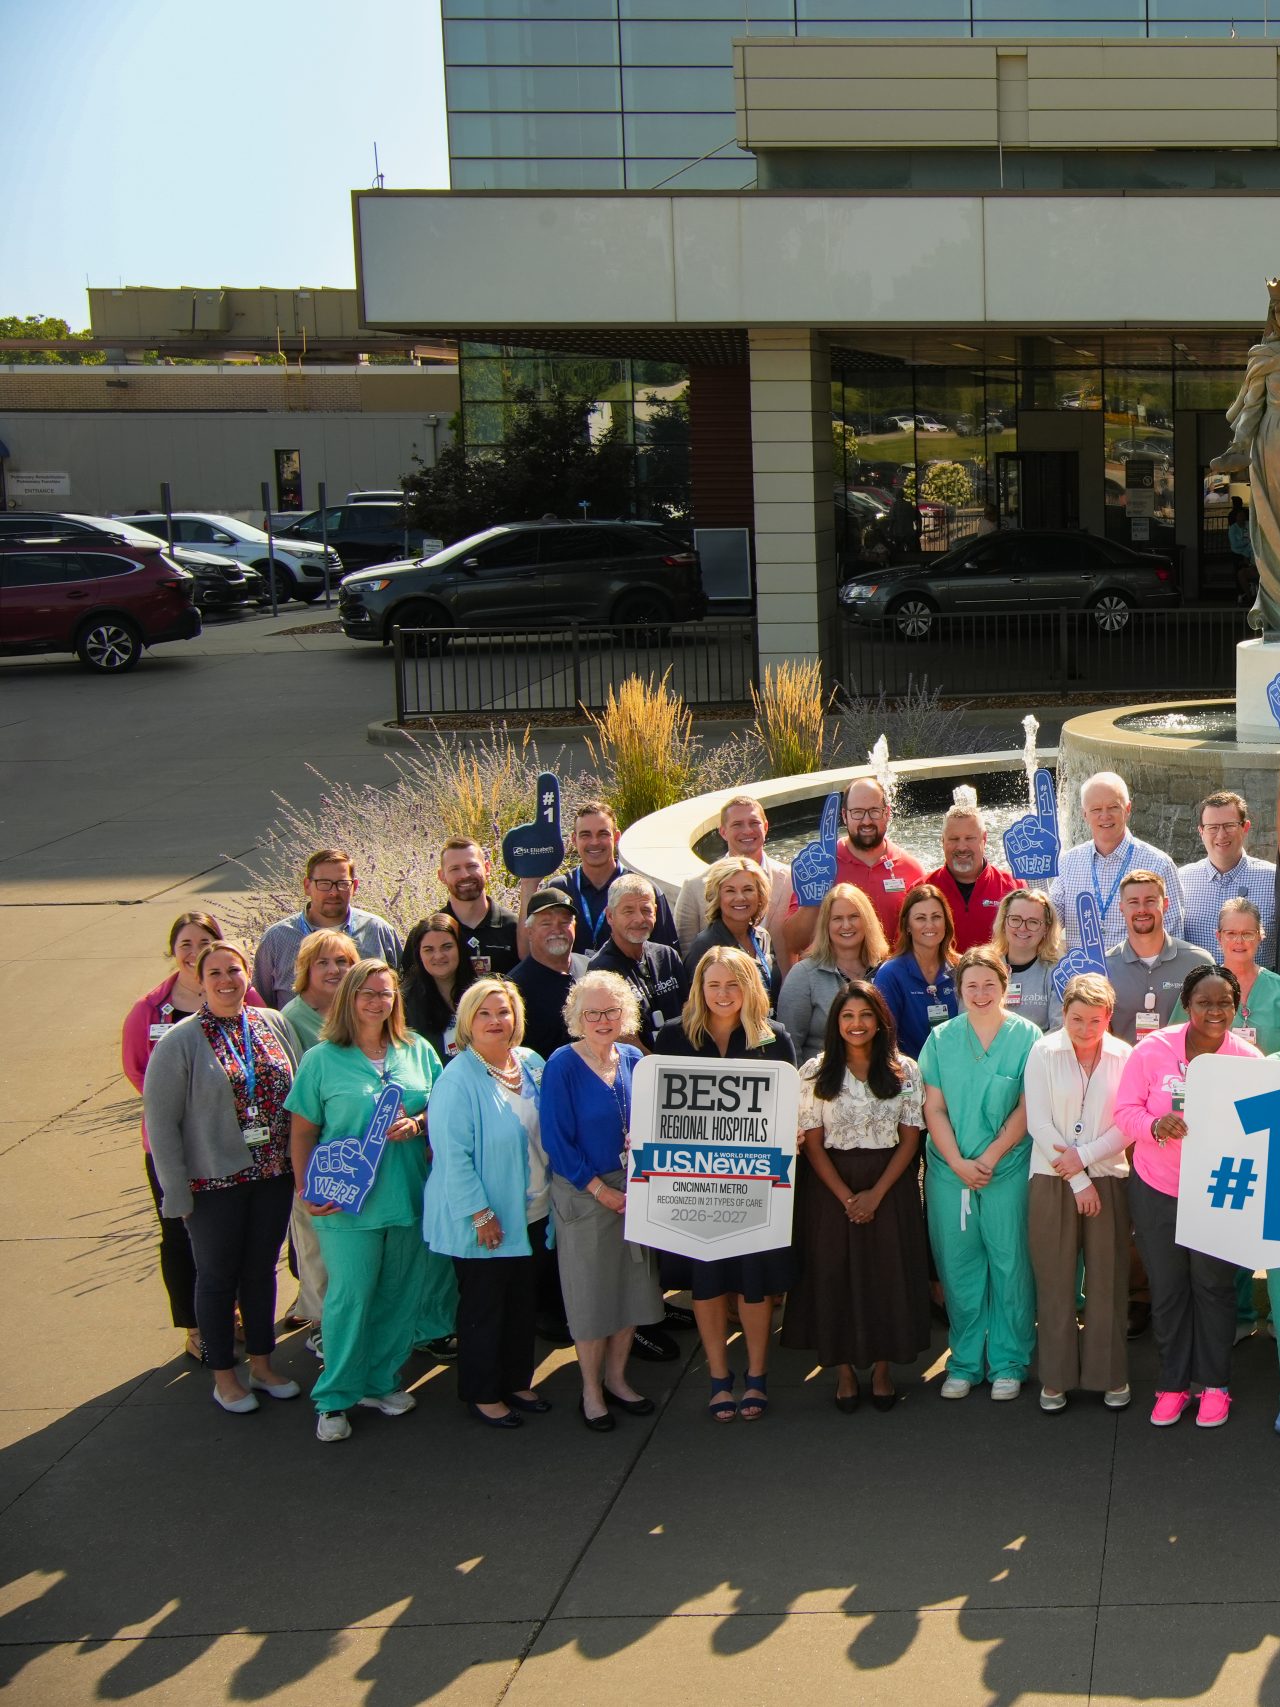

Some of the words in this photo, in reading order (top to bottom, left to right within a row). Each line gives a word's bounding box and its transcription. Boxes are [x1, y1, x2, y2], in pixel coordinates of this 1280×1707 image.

[542, 791, 555, 823] #1
[1040, 784, 1053, 816] #1
[825, 808, 835, 840] #1
[1014, 853, 1051, 874] WE'RE
[1083, 909, 1099, 946] #1
[661, 1073, 771, 1113] BEST
[370, 1104, 393, 1144] #1
[660, 1114, 709, 1141] REGIONAL
[711, 1116, 768, 1143] HOSPITALS
[314, 1176, 360, 1204] WE'RE
[657, 1195, 697, 1206] RECOGNIZED
[697, 1196, 705, 1206] IN
[705, 1197, 713, 1206] 21
[713, 1197, 735, 1207] TYPES
[735, 1198, 744, 1207] OF
[745, 1199, 763, 1208] CARE
[672, 1181, 718, 1194] CINCINNATI
[719, 1183, 748, 1195] METRO
[670, 1208, 748, 1223] 2026-2027
